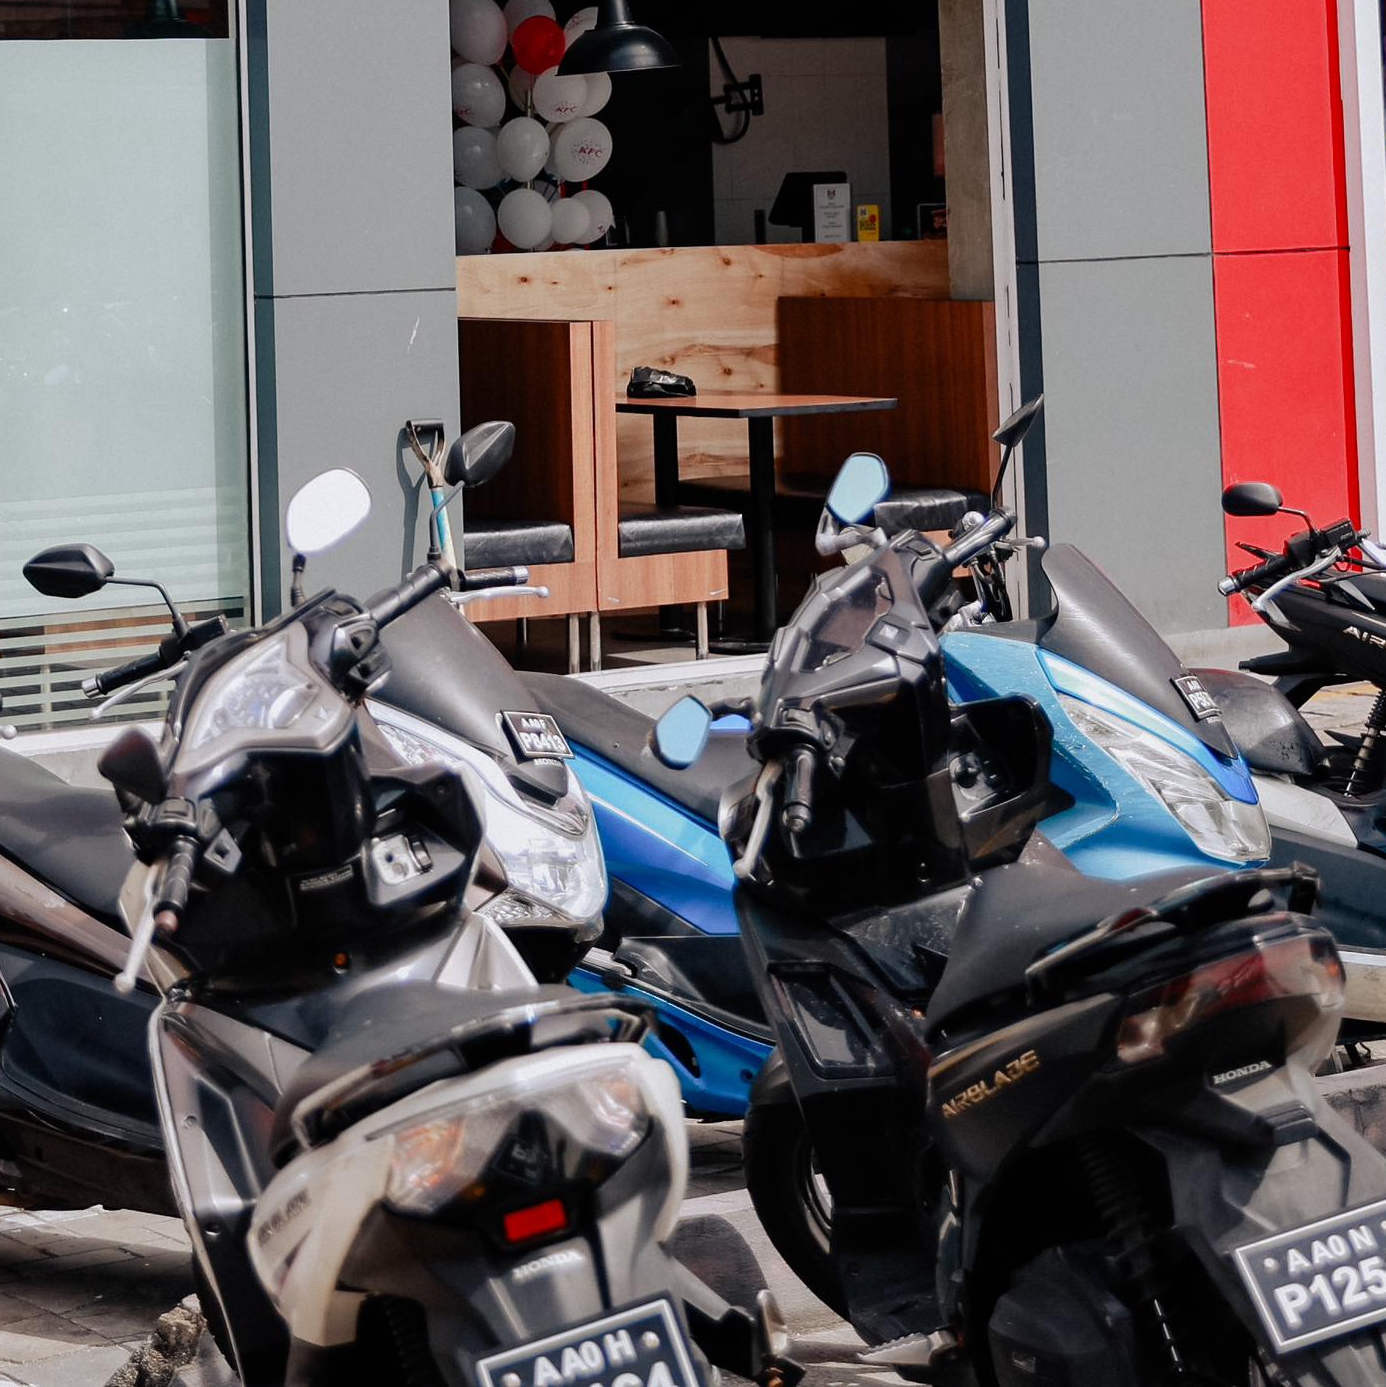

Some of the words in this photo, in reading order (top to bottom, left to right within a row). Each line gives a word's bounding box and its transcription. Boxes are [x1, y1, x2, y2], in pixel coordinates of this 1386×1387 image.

[941, 1049, 1040, 1119] AIRBLADE
[1213, 1060, 1272, 1085] HONDA
[513, 1249, 584, 1281] HONDA
